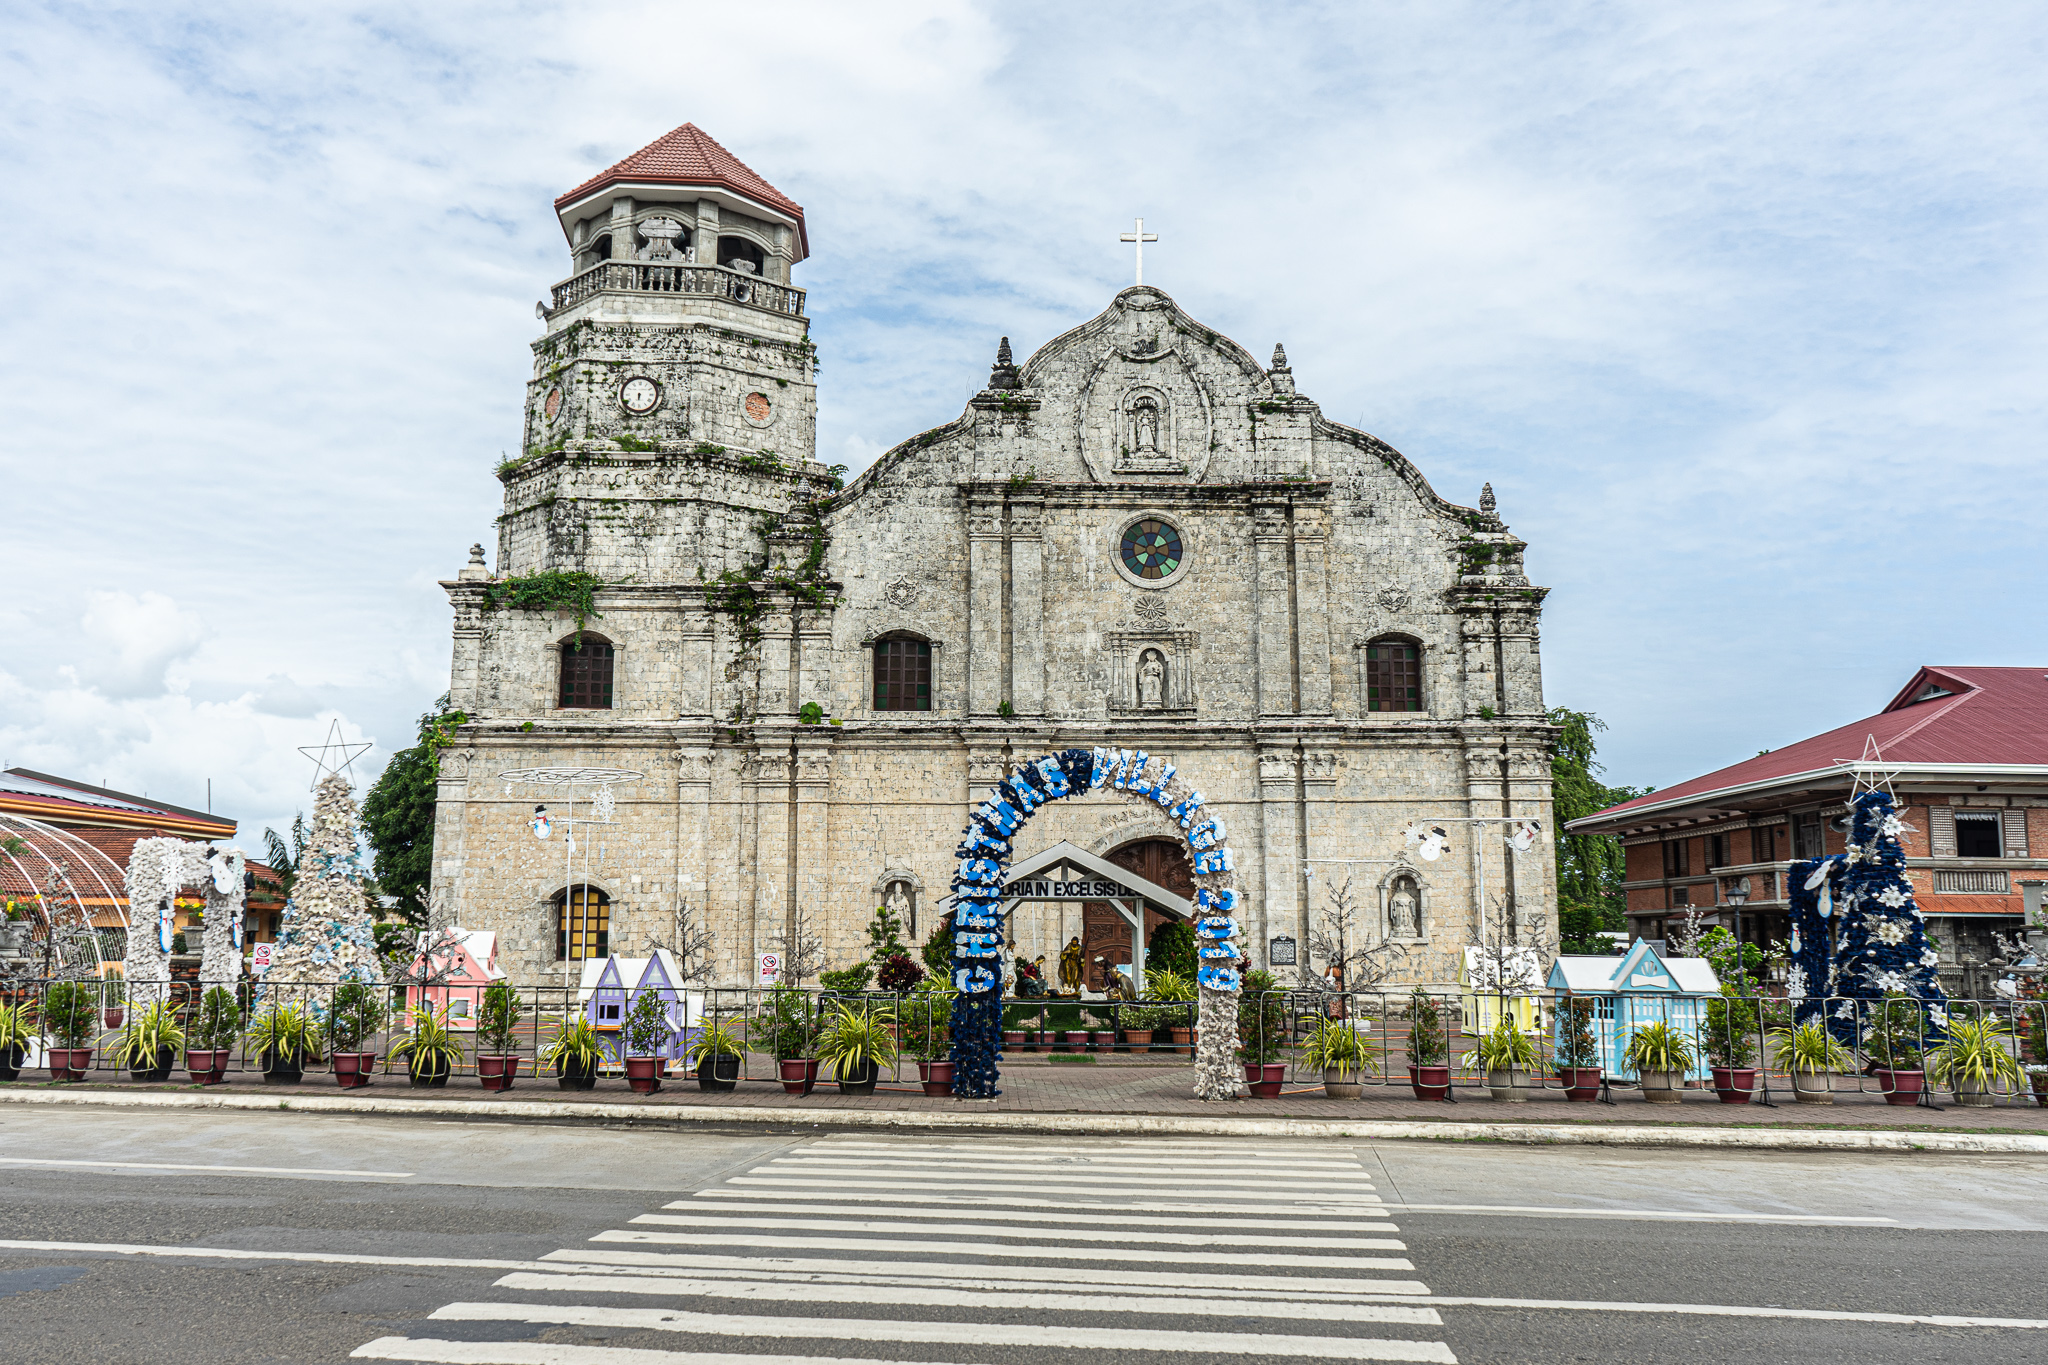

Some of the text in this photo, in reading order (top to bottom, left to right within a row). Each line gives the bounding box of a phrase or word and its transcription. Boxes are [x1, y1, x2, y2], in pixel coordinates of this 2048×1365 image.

[955, 746, 1242, 993] CHRISTMAS VILLAGE 2019
[1035, 881, 1049, 897] IN
[1054, 881, 1116, 897] EXCELSIS
[1117, 883, 1144, 897] DE
